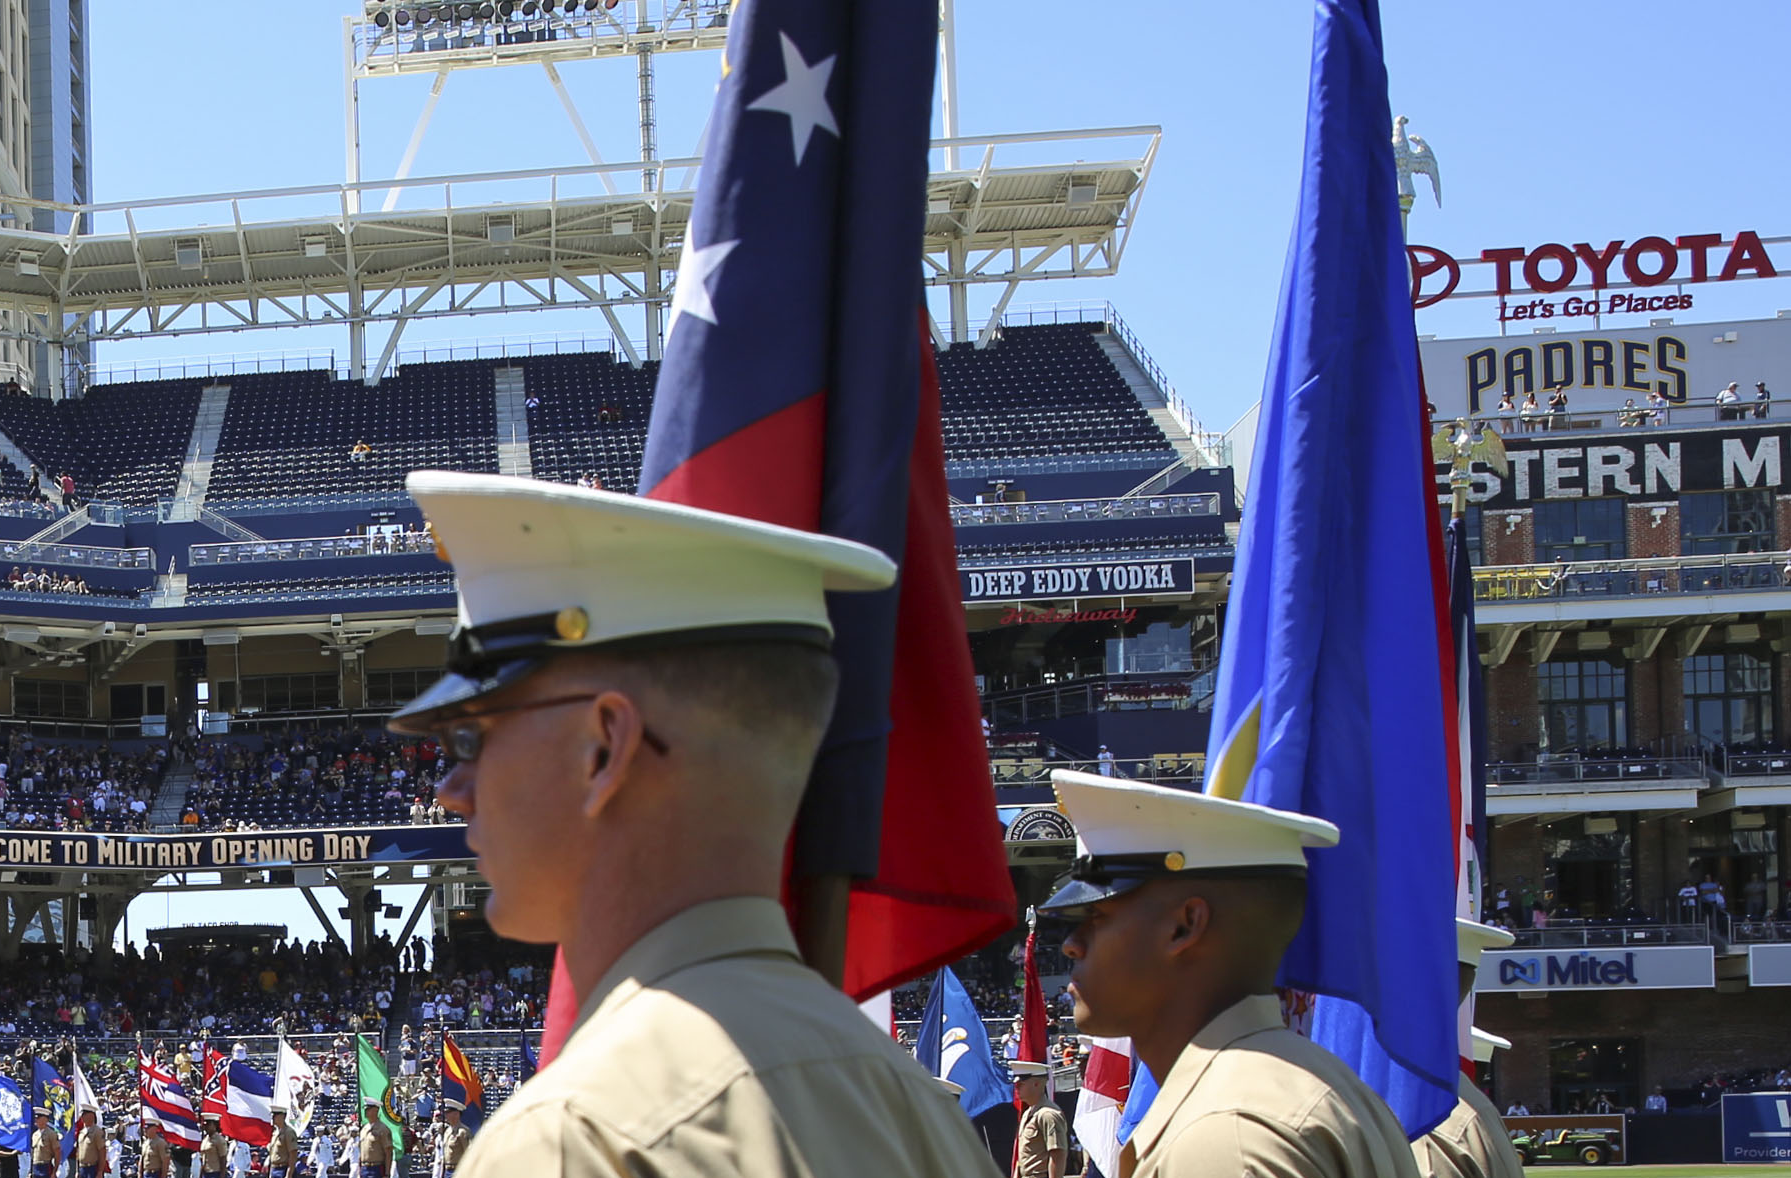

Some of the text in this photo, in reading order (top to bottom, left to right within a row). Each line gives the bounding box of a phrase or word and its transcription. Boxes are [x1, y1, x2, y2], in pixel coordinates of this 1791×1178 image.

[1481, 231, 1778, 296] TOYOTA
[1499, 293, 1694, 321] Let's Go Places
[1465, 336, 1688, 415] PADRES
[969, 564, 1175, 597] DEEP EDDY VODKA
[1000, 607, 1139, 624] Hideaway
[61, 838, 88, 864] TO
[97, 837, 203, 867] MILITARY
[211, 837, 313, 865] OPENING
[323, 833, 371, 861] DAY
[1547, 951, 1637, 985] Mitel
